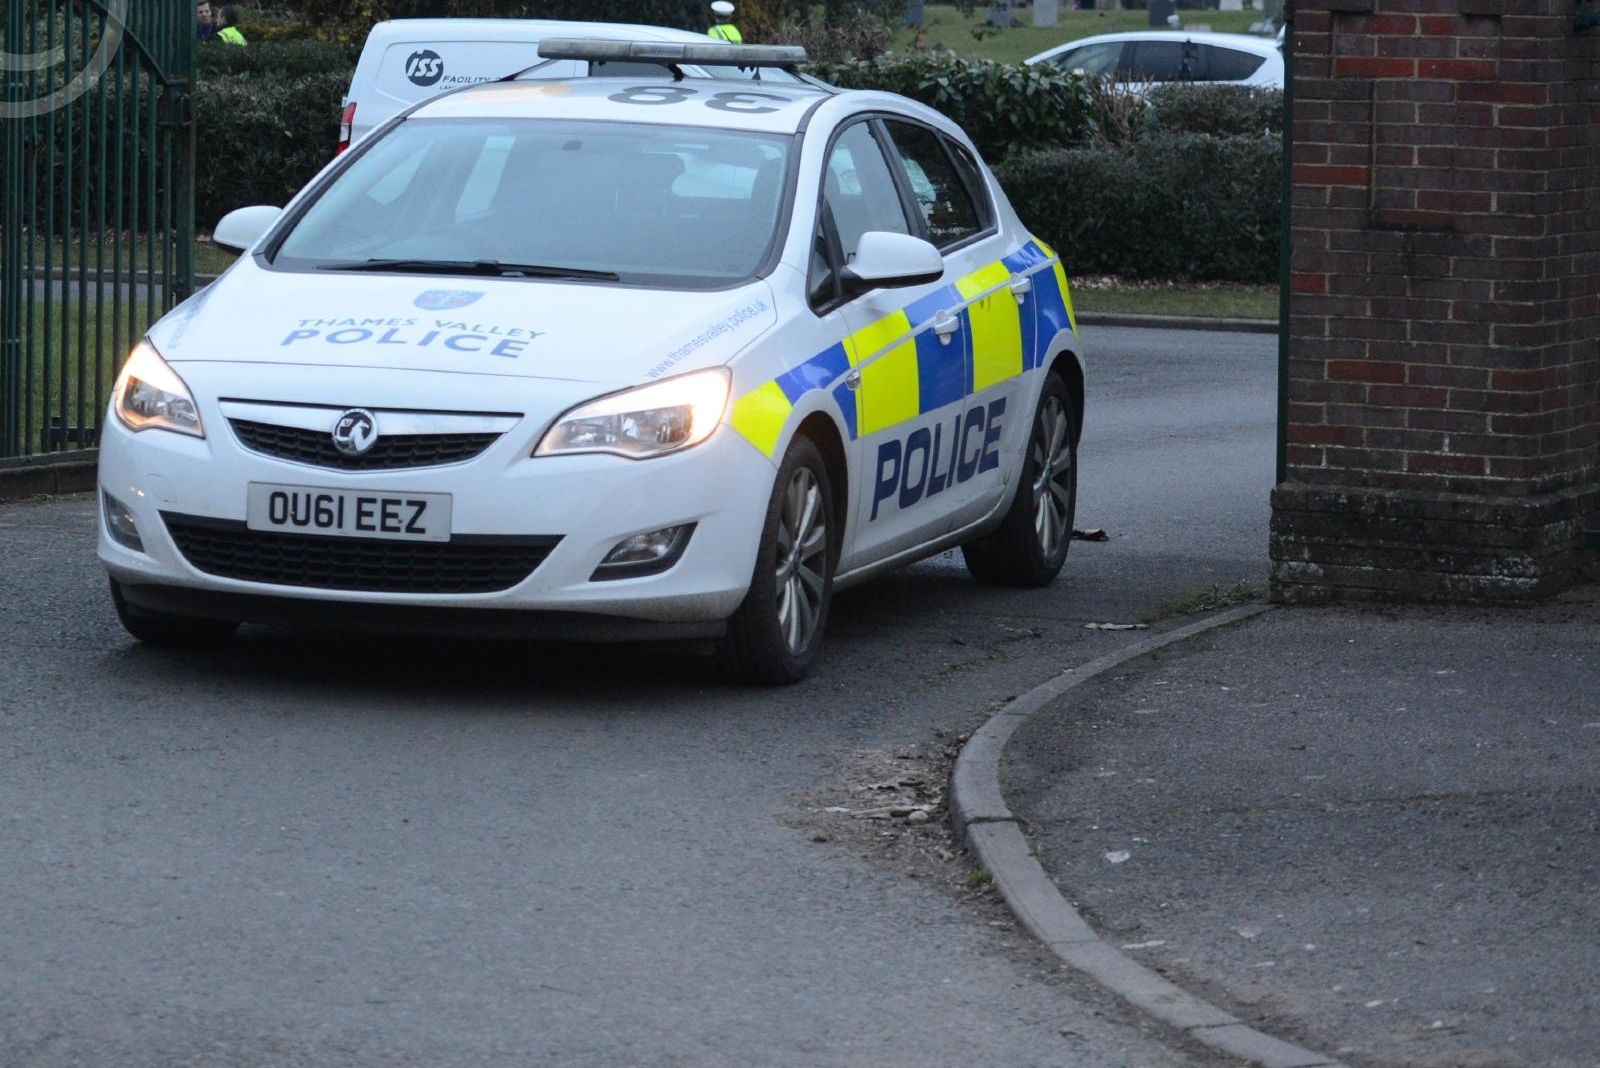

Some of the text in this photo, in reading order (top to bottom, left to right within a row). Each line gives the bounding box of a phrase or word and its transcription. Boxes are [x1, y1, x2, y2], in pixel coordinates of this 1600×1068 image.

[280, 328, 530, 358] POLICE
[297, 318, 548, 339] THAMES VALLEY
[869, 397, 1007, 522] POLICE
[269, 491, 427, 535] OU61 EEZ
